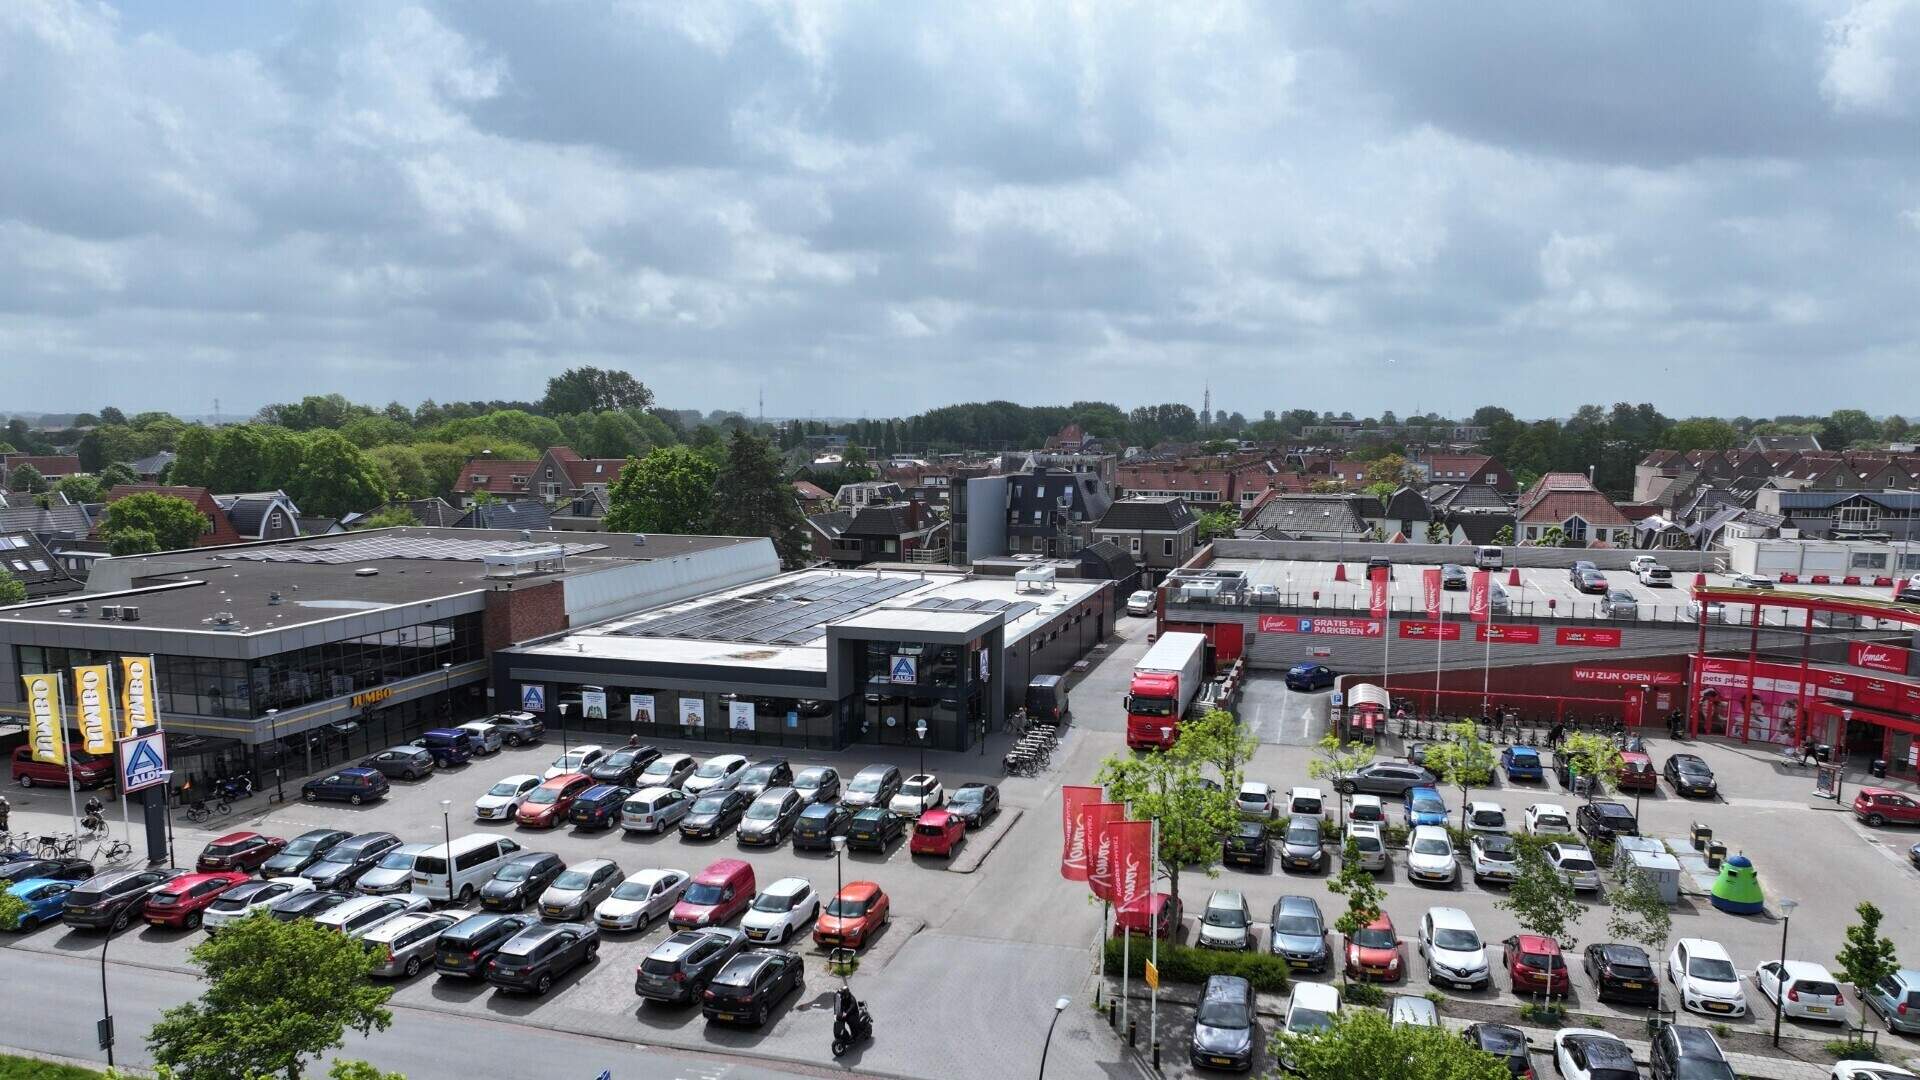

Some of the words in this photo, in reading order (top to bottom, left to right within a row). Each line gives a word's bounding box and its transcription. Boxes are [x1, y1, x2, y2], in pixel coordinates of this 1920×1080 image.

[1262, 616, 1287, 631] Vomar
[1301, 620, 1310, 631] P
[1313, 619, 1348, 627] GRATIS
[1313, 626, 1364, 636] PARKEREN
[1858, 645, 1891, 665] Vomar
[1575, 670, 1595, 679] WIJ
[1597, 671, 1620, 680] ZIJN
[1622, 672, 1650, 681] OPEN
[352, 688, 392, 709] JUMBO
[131, 768, 161, 786] ALDI
